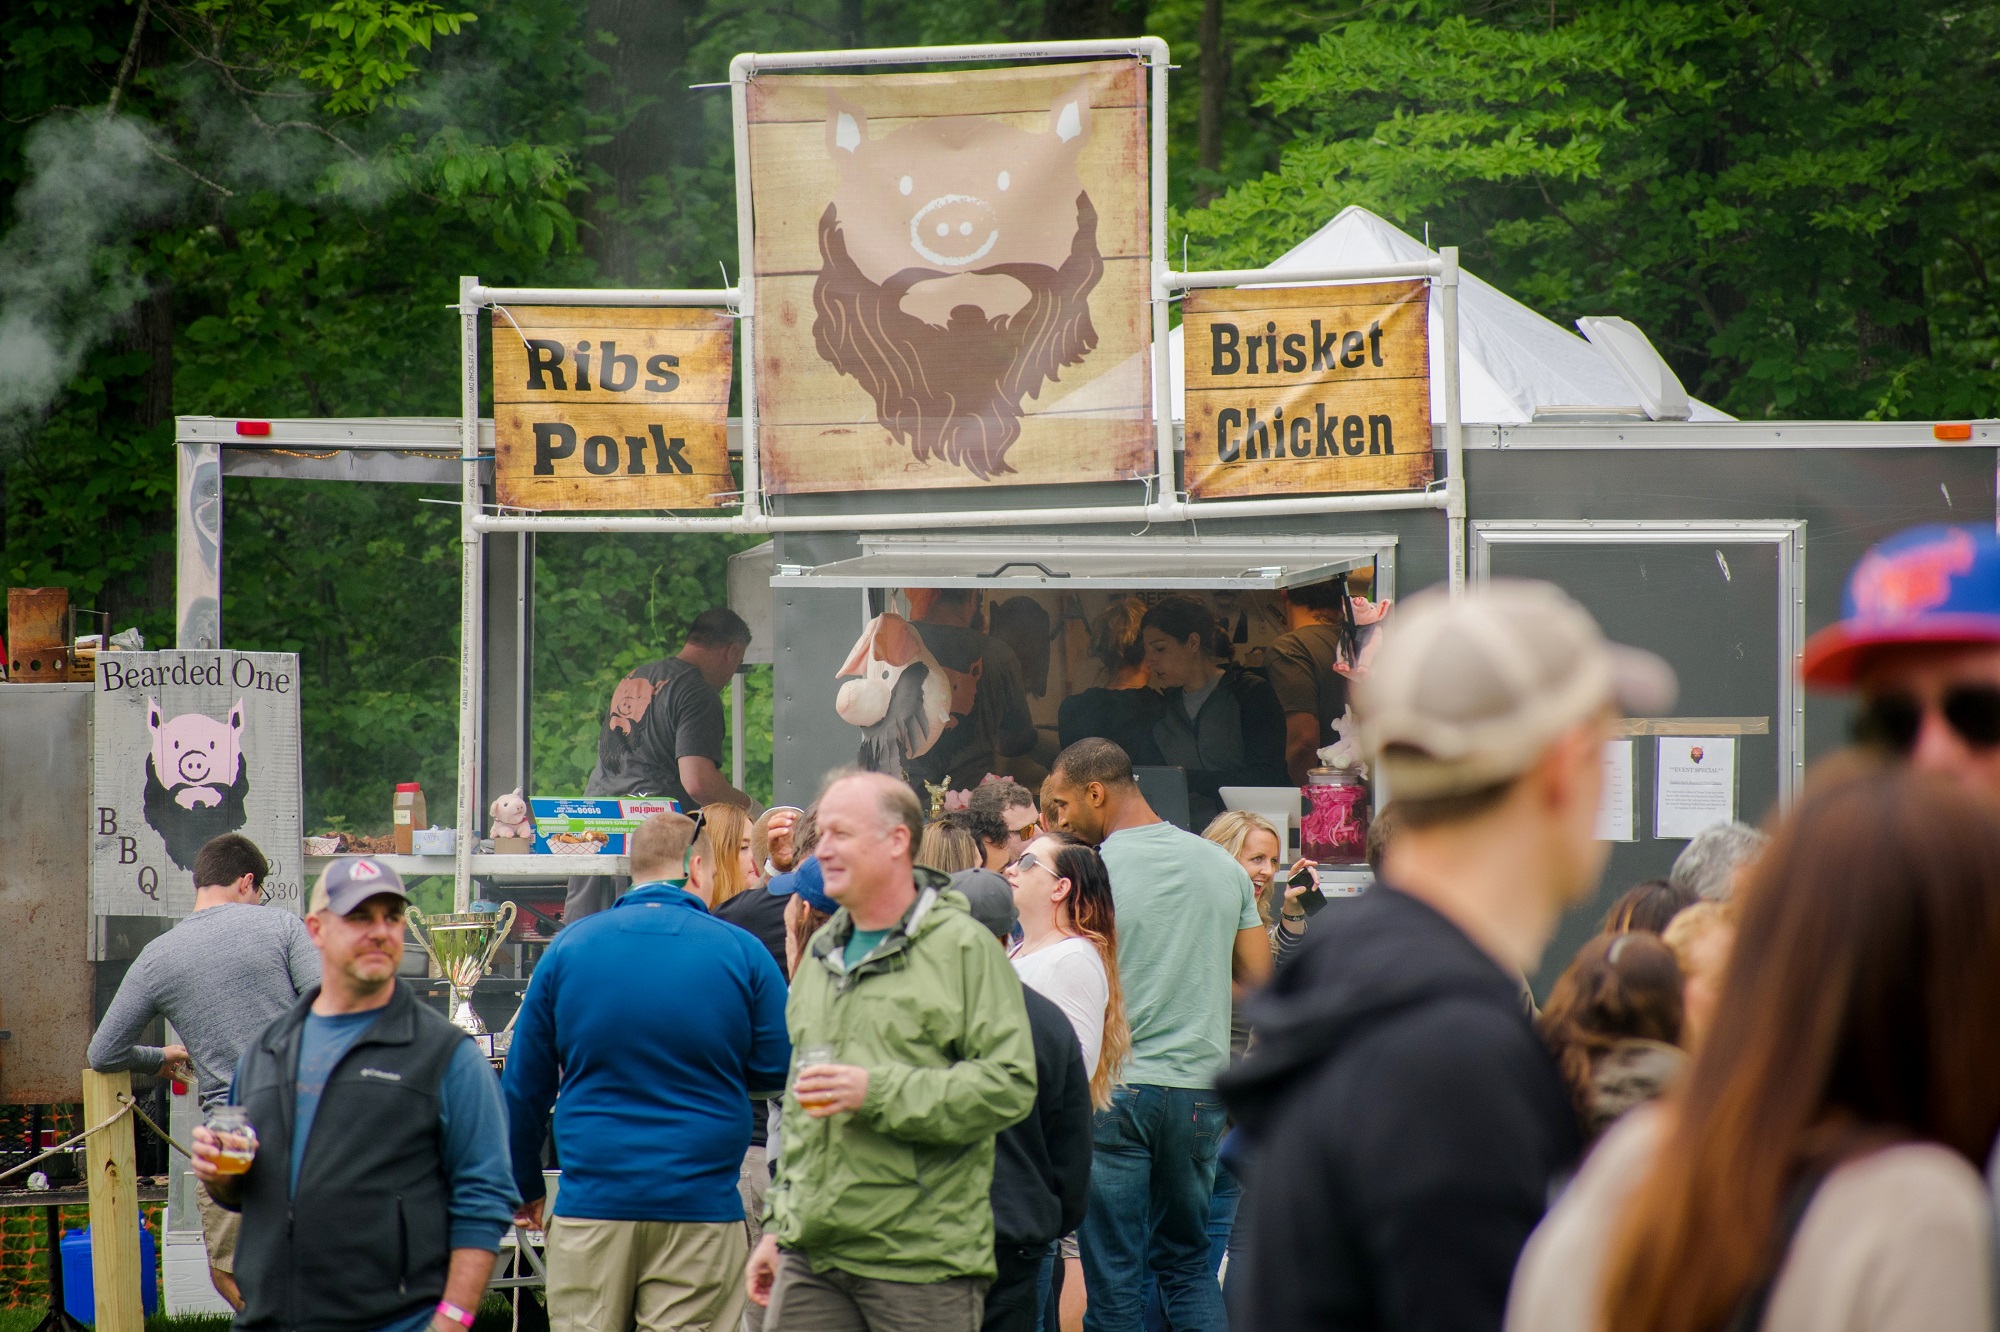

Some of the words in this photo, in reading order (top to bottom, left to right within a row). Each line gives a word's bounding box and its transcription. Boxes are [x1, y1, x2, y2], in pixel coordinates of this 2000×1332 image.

[523, 338, 681, 393] Ribs
[1210, 319, 1384, 376] Brisket
[532, 422, 693, 476] Pork
[1217, 402, 1395, 463] Chicken
[100, 656, 224, 692] Bearded
[231, 658, 290, 693] One
